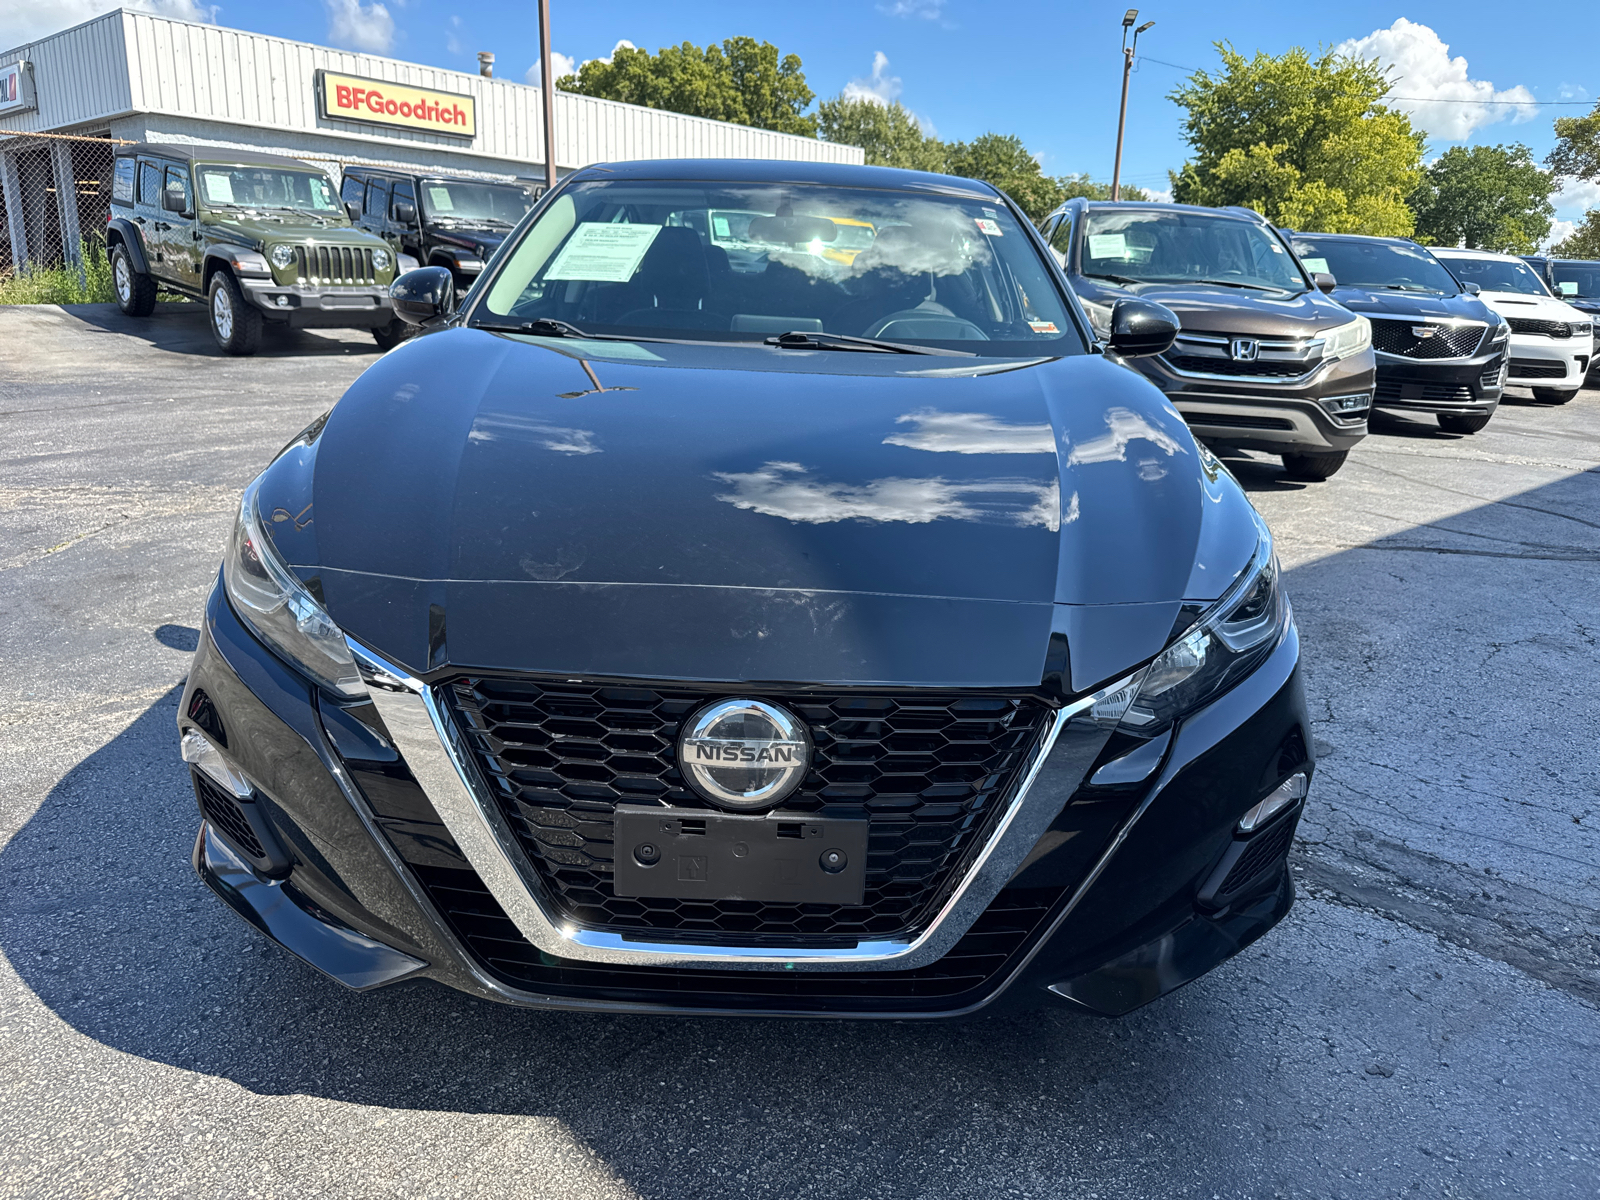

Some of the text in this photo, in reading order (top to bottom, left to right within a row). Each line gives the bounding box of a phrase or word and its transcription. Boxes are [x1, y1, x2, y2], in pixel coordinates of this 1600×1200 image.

[0, 78, 9, 103] AL
[336, 84, 467, 126] BFGoodrich
[696, 744, 792, 762] NISSAN
